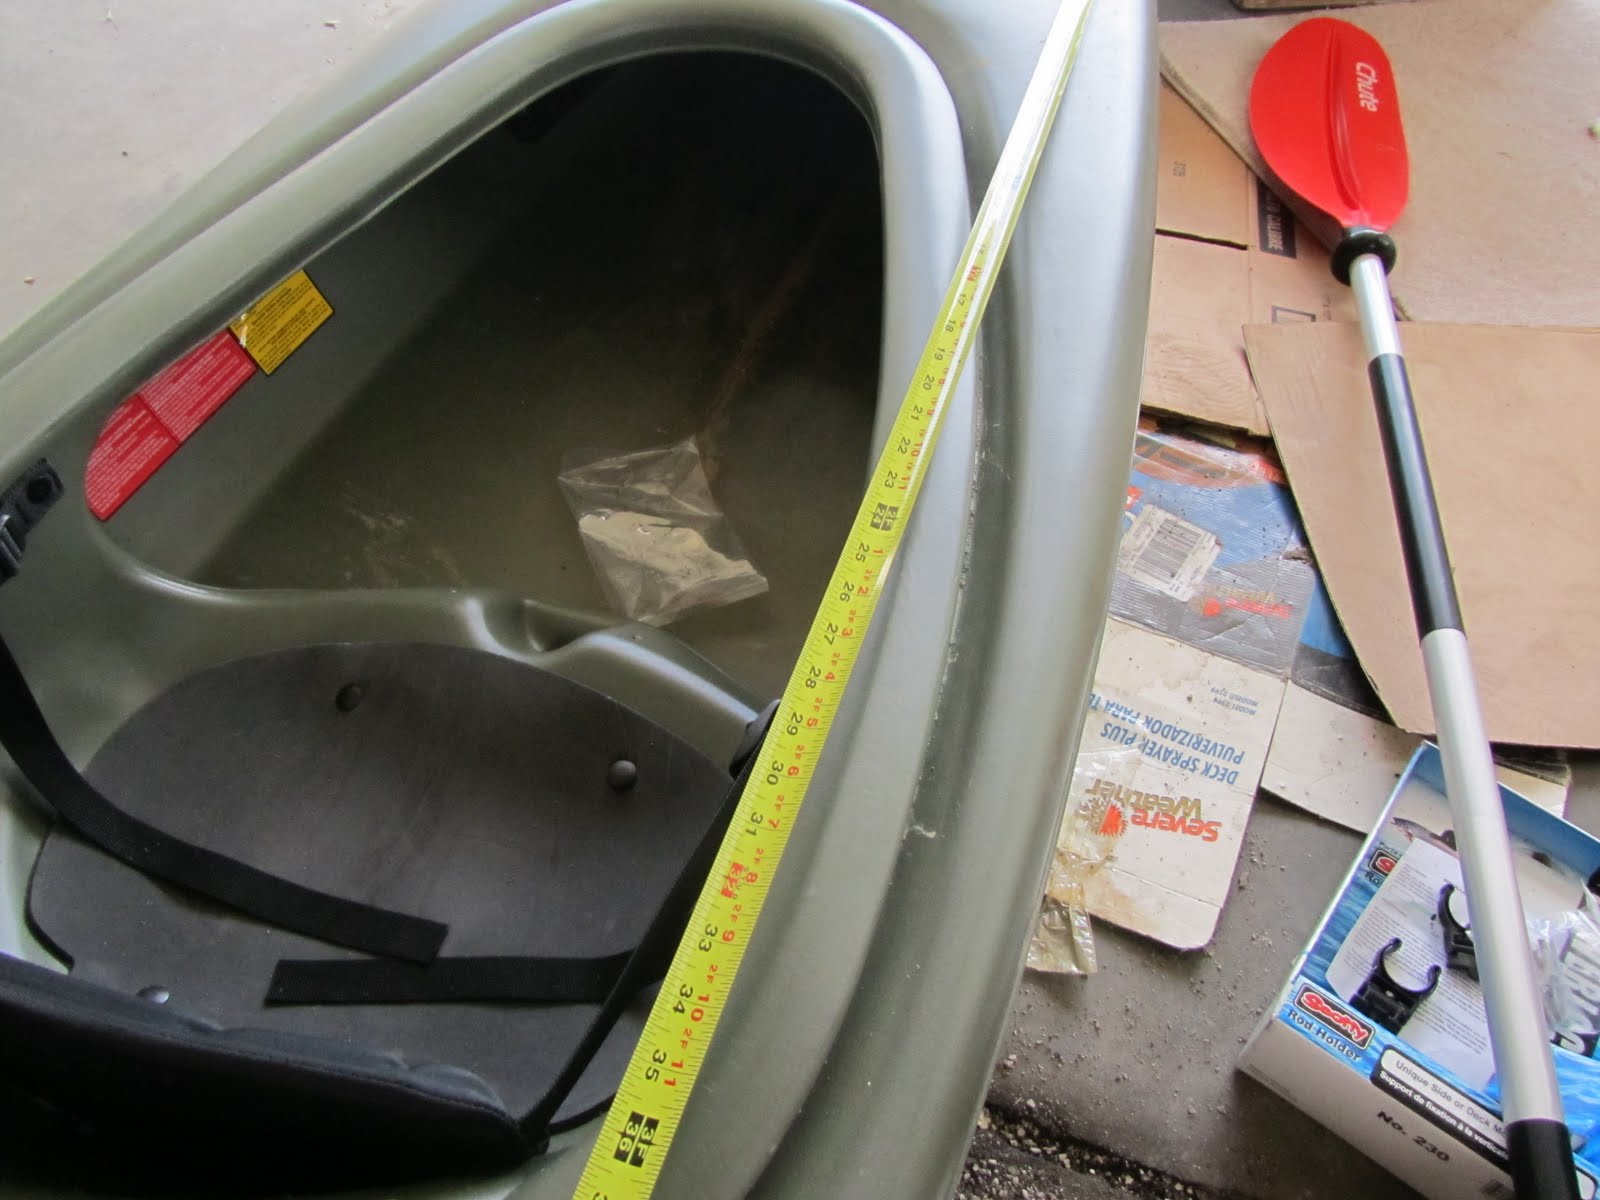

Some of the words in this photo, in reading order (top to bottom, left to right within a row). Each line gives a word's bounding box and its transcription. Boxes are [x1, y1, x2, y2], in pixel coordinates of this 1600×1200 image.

[1356, 62, 1379, 112] Chute
[945, 320, 956, 332] 18
[934, 347, 945, 361] 19
[923, 374, 935, 391] 20
[911, 405, 923, 421] 21
[897, 436, 911, 455] 22
[884, 470, 898, 489] 23
[855, 542, 870, 563] 25
[839, 581, 855, 603] 26
[857, 586, 869, 595] 2
[824, 622, 838, 645] 27
[842, 628, 853, 637] 3
[805, 666, 822, 689] 28
[824, 672, 836, 681] 4
[786, 712, 804, 736] 29
[806, 717, 819, 728] 5
[1101, 722, 1137, 746] PLUS
[1138, 738, 1201, 774] SPRAYER
[766, 760, 784, 785] 30
[787, 765, 799, 776] 6
[1200, 766, 1240, 785] DECK
[1085, 779, 1202, 819] Weather
[745, 812, 763, 836] 31
[767, 818, 781, 829] 7
[1130, 808, 1222, 842] Severe
[745, 871, 758, 883] 8
[698, 923, 718, 952] 33
[722, 930, 735, 942] 9
[673, 983, 693, 1015] 34
[690, 993, 710, 1022] 10
[1288, 1009, 1314, 1031] Rod
[1315, 1028, 1361, 1060] Holder
[645, 1049, 667, 1082] 35
[663, 1059, 684, 1087] 11
[1379, 1070, 1413, 1097] Support
[1413, 1092, 1425, 1105] de
[1425, 1101, 1457, 1126] fixation
[1464, 1126, 1473, 1137] la
[1396, 1060, 1429, 1087] Unique
[1431, 1083, 1453, 1102] Side
[1454, 1099, 1465, 1110] or
[1466, 1106, 1490, 1127] Deck
[619, 1121, 639, 1152] 36
[636, 1126, 655, 1158] 3F
[1377, 1111, 1407, 1136] No.
[1412, 1135, 1450, 1162] 230
